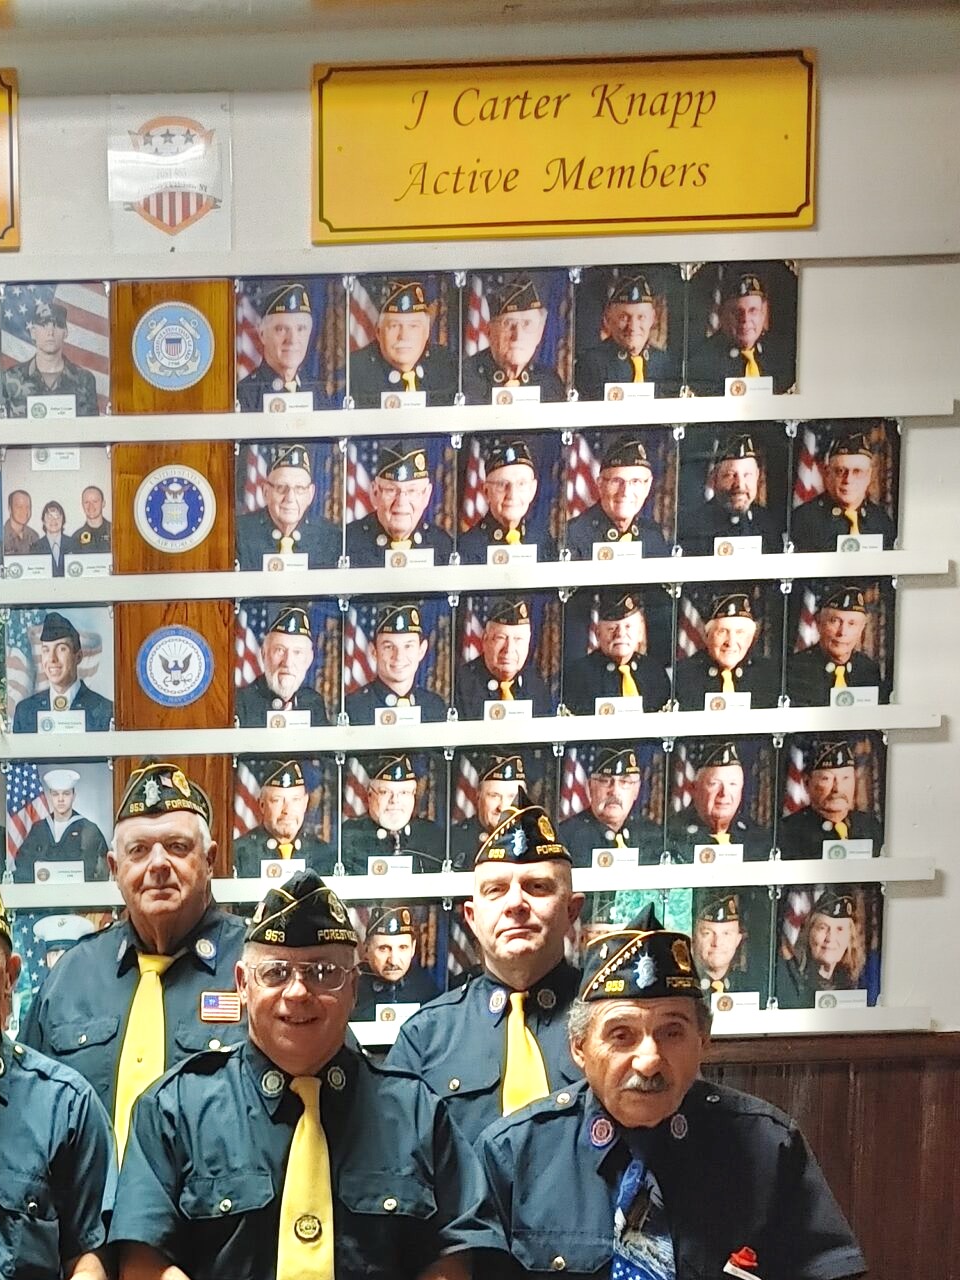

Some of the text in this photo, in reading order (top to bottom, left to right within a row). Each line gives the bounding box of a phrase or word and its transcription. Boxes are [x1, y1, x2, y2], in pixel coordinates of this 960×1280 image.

[404, 82, 716, 131] J Carter Knapp
[393, 148, 710, 202] Active Members
[264, 928, 287, 943] 953
